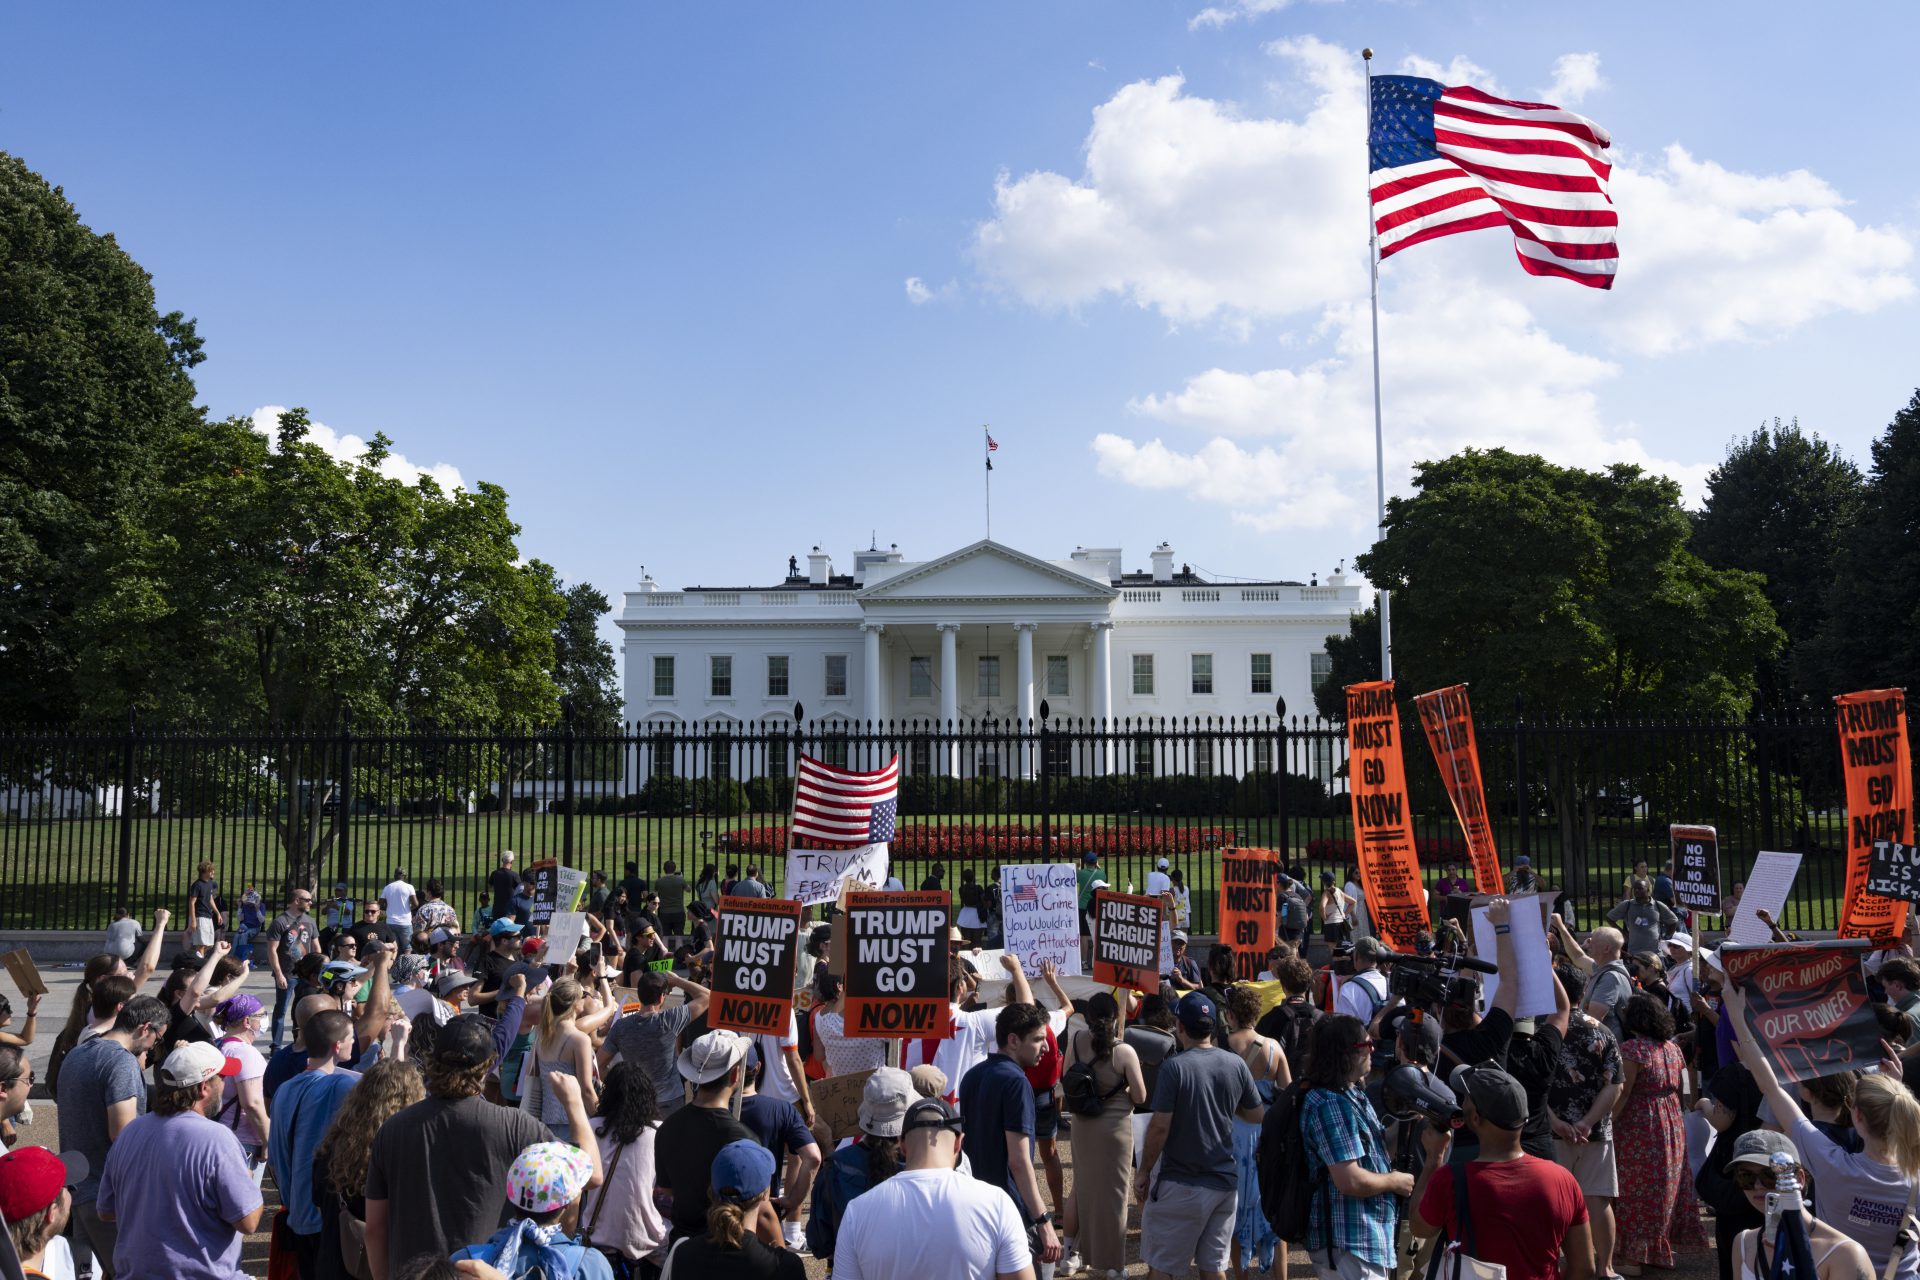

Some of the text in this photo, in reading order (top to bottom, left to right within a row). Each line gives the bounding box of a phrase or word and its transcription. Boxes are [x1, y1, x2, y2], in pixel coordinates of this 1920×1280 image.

[1347, 689, 1394, 720] TRUMP
[1838, 698, 1905, 733] TRUMP
[1353, 720, 1393, 750] MUST
[1848, 732, 1901, 767] MUST
[1363, 758, 1385, 785] GO
[1868, 774, 1893, 805] GO
[1356, 793, 1402, 828] NOW
[1853, 809, 1905, 848] NOW
[1684, 857, 1705, 867] ICE!
[1686, 844, 1702, 855] NO
[538, 872, 547, 880] NO
[1222, 858, 1276, 883] TRUMP
[1687, 871, 1701, 881] NO
[1890, 864, 1912, 880] IS
[537, 893, 544, 901] NO
[852, 895, 942, 904] RefuseFascism.org
[1227, 887, 1272, 912] MUST
[1674, 880, 1717, 896] NATIONAL
[1679, 894, 1712, 906] GUARD!
[723, 899, 795, 912] RefuseFascism.org
[1005, 895, 1039, 914] About
[1102, 901, 1156, 926] ¡QUE SE
[1378, 910, 1423, 923] REFUSE
[721, 913, 796, 940] TRUMP
[850, 910, 946, 935] TRUMP
[1005, 918, 1027, 937] You
[1100, 920, 1155, 946] LARGUE
[1236, 920, 1258, 945] GO
[723, 939, 785, 966] MUST
[859, 938, 935, 964] MUST
[1008, 933, 1079, 951] Have Attacked
[1101, 941, 1153, 966] TRUMP
[1233, 952, 1268, 982] OW
[1728, 952, 1759, 973] OUR
[1763, 956, 1842, 992] OUR MINDS
[735, 966, 767, 992] GO
[876, 966, 916, 992] GO
[1113, 965, 1140, 986] YA!
[720, 998, 782, 1027] NOW!
[860, 1003, 937, 1029] NOW!
[1764, 990, 1851, 1039] OUR POWER
